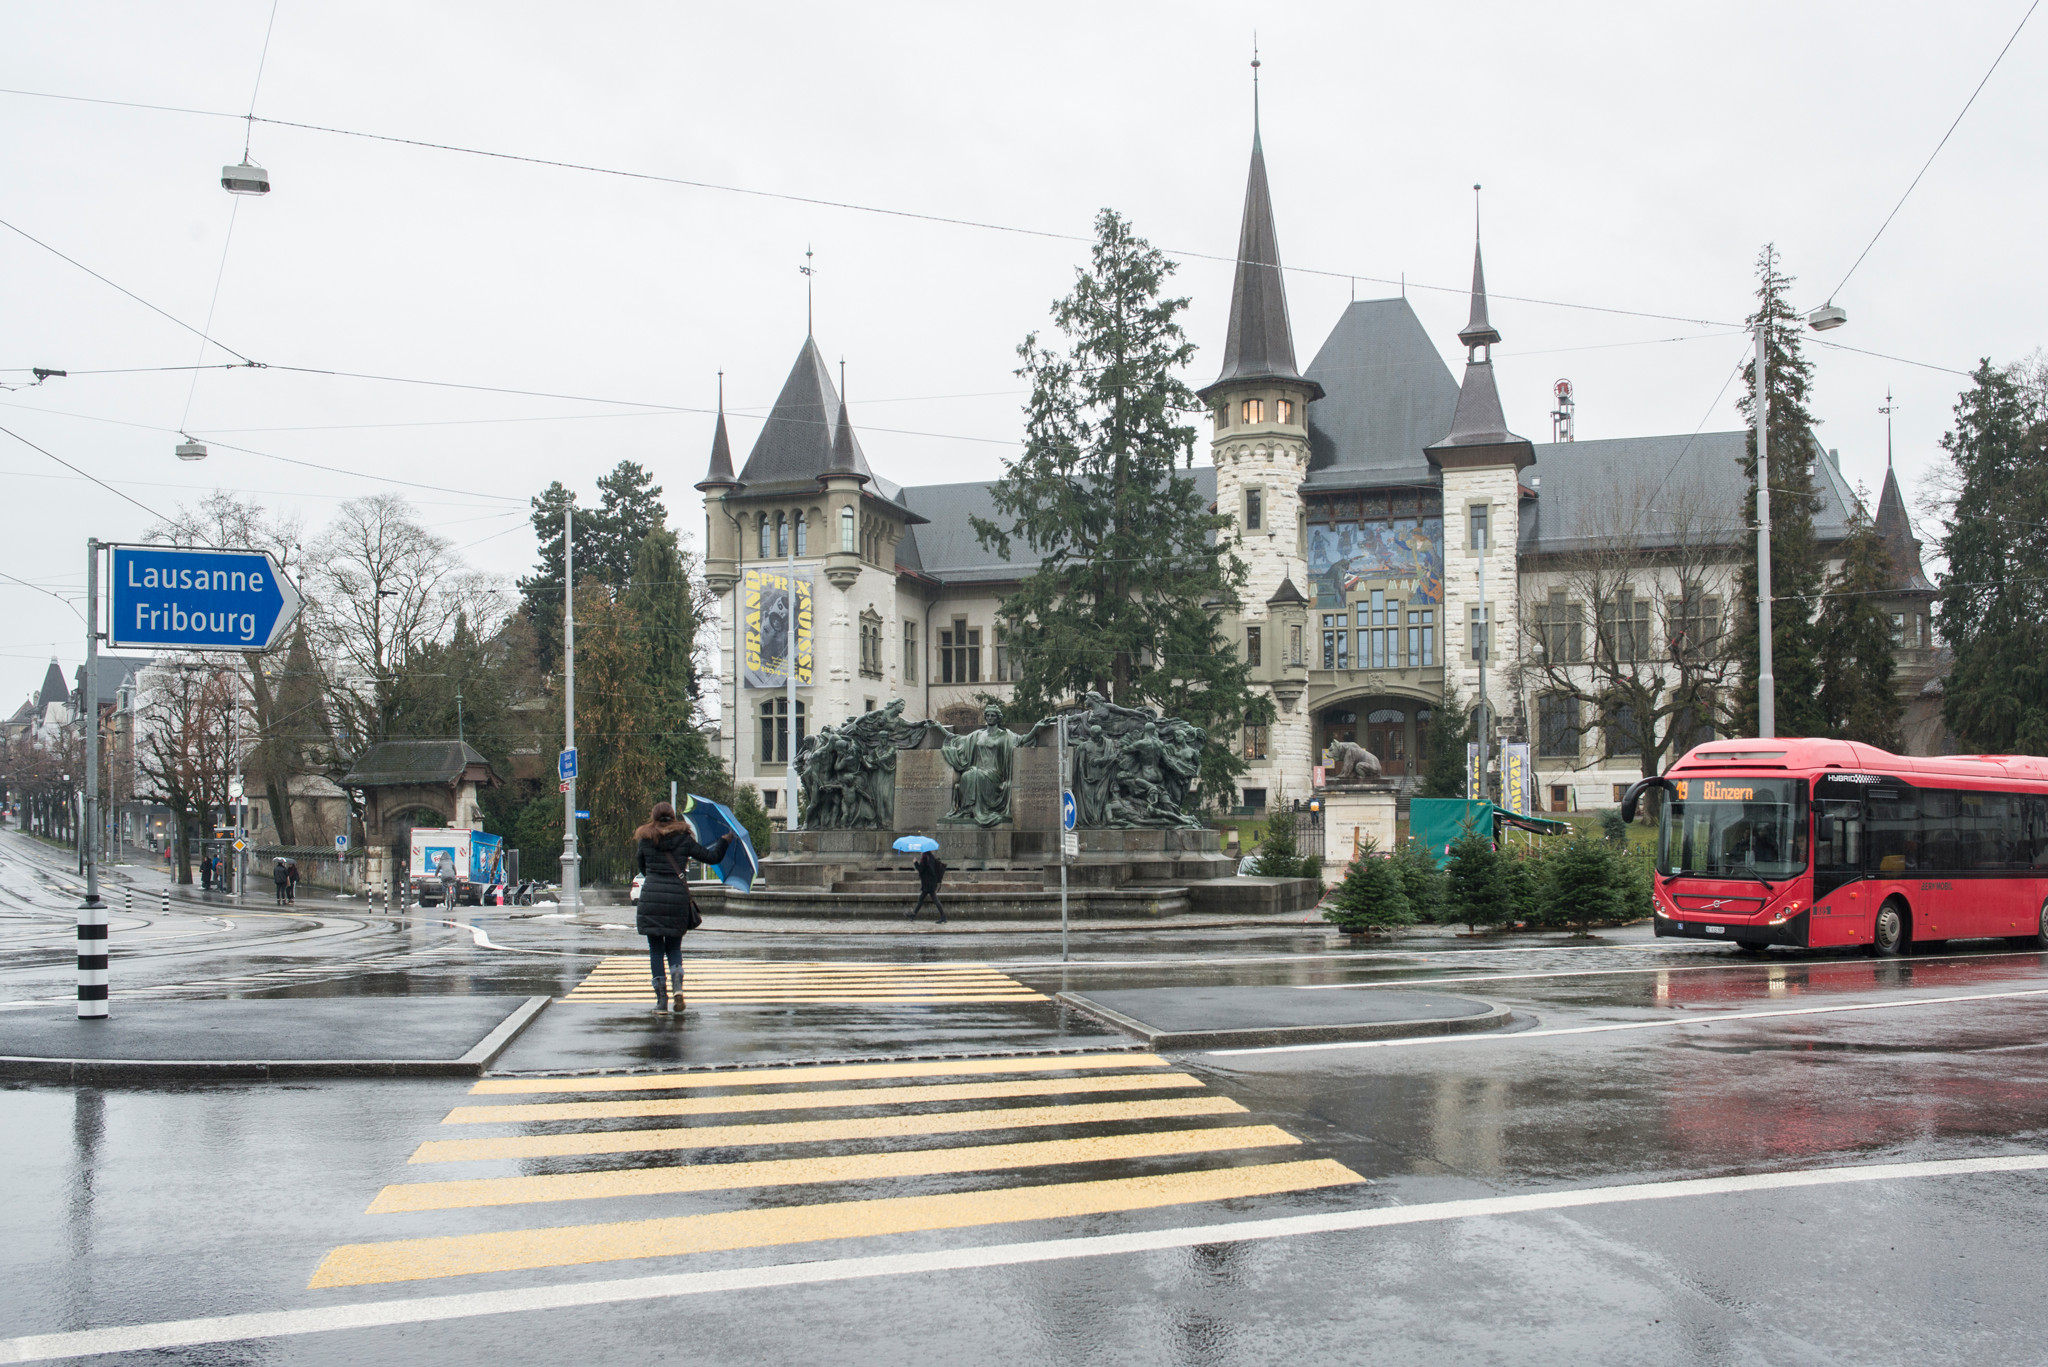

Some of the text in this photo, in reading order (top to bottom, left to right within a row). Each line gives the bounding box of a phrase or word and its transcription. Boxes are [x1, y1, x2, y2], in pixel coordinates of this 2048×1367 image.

[128, 560, 264, 593] Lausanne
[761, 573, 811, 597] PRX
[136, 602, 255, 641] Fribourg
[746, 570, 761, 671] GRAND
[798, 597, 812, 684] SUISSE
[1676, 780, 1754, 800] 19 Blinzern
[1827, 774, 1855, 782] HYBRID
